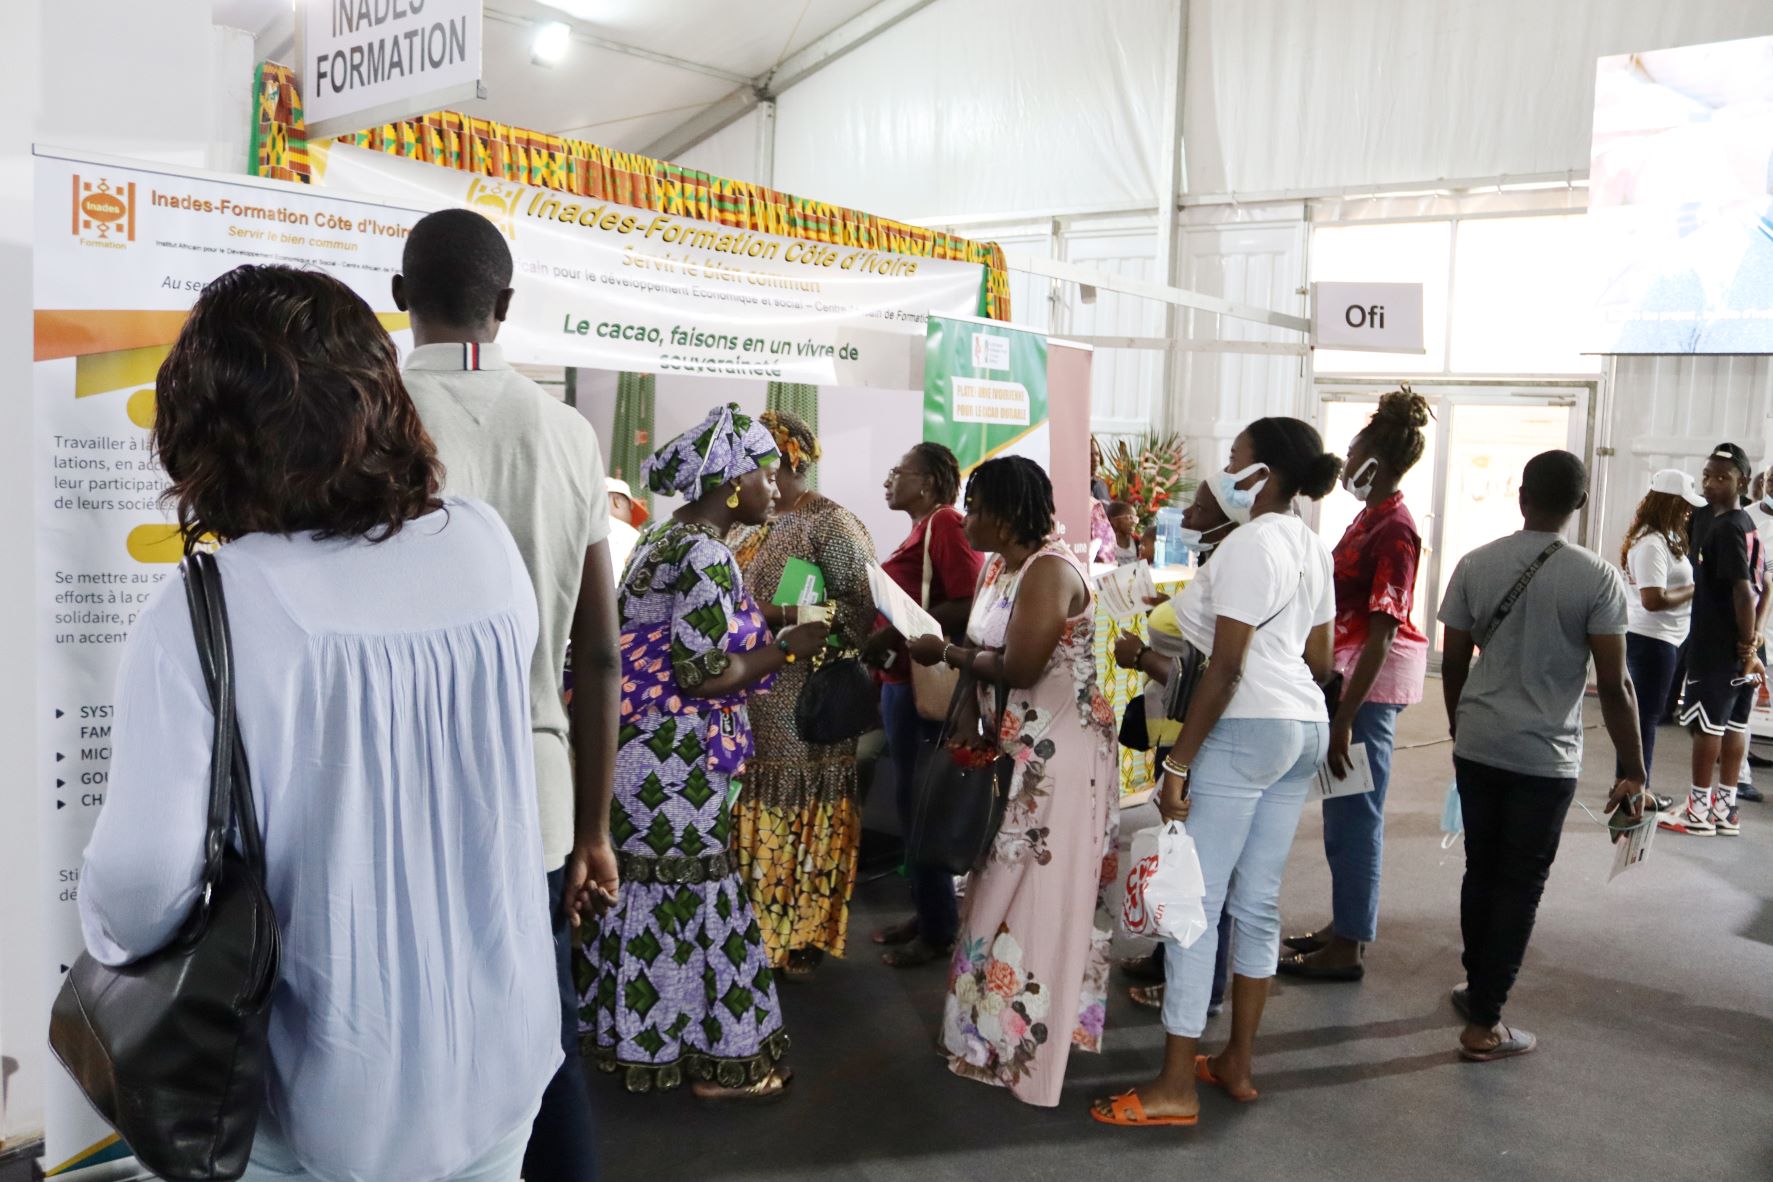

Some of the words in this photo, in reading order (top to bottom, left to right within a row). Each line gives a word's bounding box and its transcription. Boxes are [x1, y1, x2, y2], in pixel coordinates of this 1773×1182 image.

[316, 15, 466, 97] FORMATION
[86, 201, 120, 213] Inades
[152, 190, 309, 225] Inades-Formation
[314, 212, 353, 231] Côte
[357, 218, 412, 239] d'Ivoir
[526, 191, 781, 260] Inades-Formation
[784, 240, 838, 268] Côte
[80, 238, 127, 250] Formation
[228, 225, 264, 239] Servir
[267, 231, 278, 242] le
[280, 232, 305, 245] bien
[308, 238, 358, 252] commun
[203, 246, 217, 254] pour
[622, 244, 678, 273] Servir
[682, 254, 698, 277] le
[702, 257, 742, 284] bien
[748, 270, 822, 293] commun
[161, 276, 181, 290] Au
[185, 281, 208, 291] ser
[553, 266, 581, 280] pour
[585, 269, 596, 282] le
[884, 309, 894, 320] de
[896, 310, 928, 324] Formatio
[1345, 304, 1385, 329] Ofi
[563, 314, 590, 335] Le
[596, 321, 664, 347] cacao,
[670, 325, 738, 351] faisons
[743, 336, 765, 353] en
[770, 338, 791, 356] un
[797, 338, 834, 357] vivre
[838, 342, 859, 360] de
[54, 435, 126, 450] Travailler
[129, 436, 138, 451] à
[54, 456, 110, 471] lations,
[115, 460, 133, 471] en
[138, 460, 162, 471] acc
[54, 476, 84, 489] leur
[89, 477, 172, 492] participatio
[54, 497, 73, 510] de
[77, 497, 114, 510] leurs
[55, 572, 73, 584] Se
[77, 572, 128, 584] mettre
[131, 574, 148, 584] au
[153, 574, 167, 583] se
[55, 591, 104, 604] efforts
[108, 591, 116, 604] à
[120, 591, 133, 604] la
[55, 611, 124, 626] solidaire,
[56, 634, 75, 644] un
[80, 705, 114, 718] SYST
[81, 726, 111, 739] FAM
[81, 748, 112, 761] MIC
[81, 771, 109, 785] GO
[81, 793, 103, 806] CH
[59, 868, 78, 882] Sti
[59, 888, 77, 902] dé
